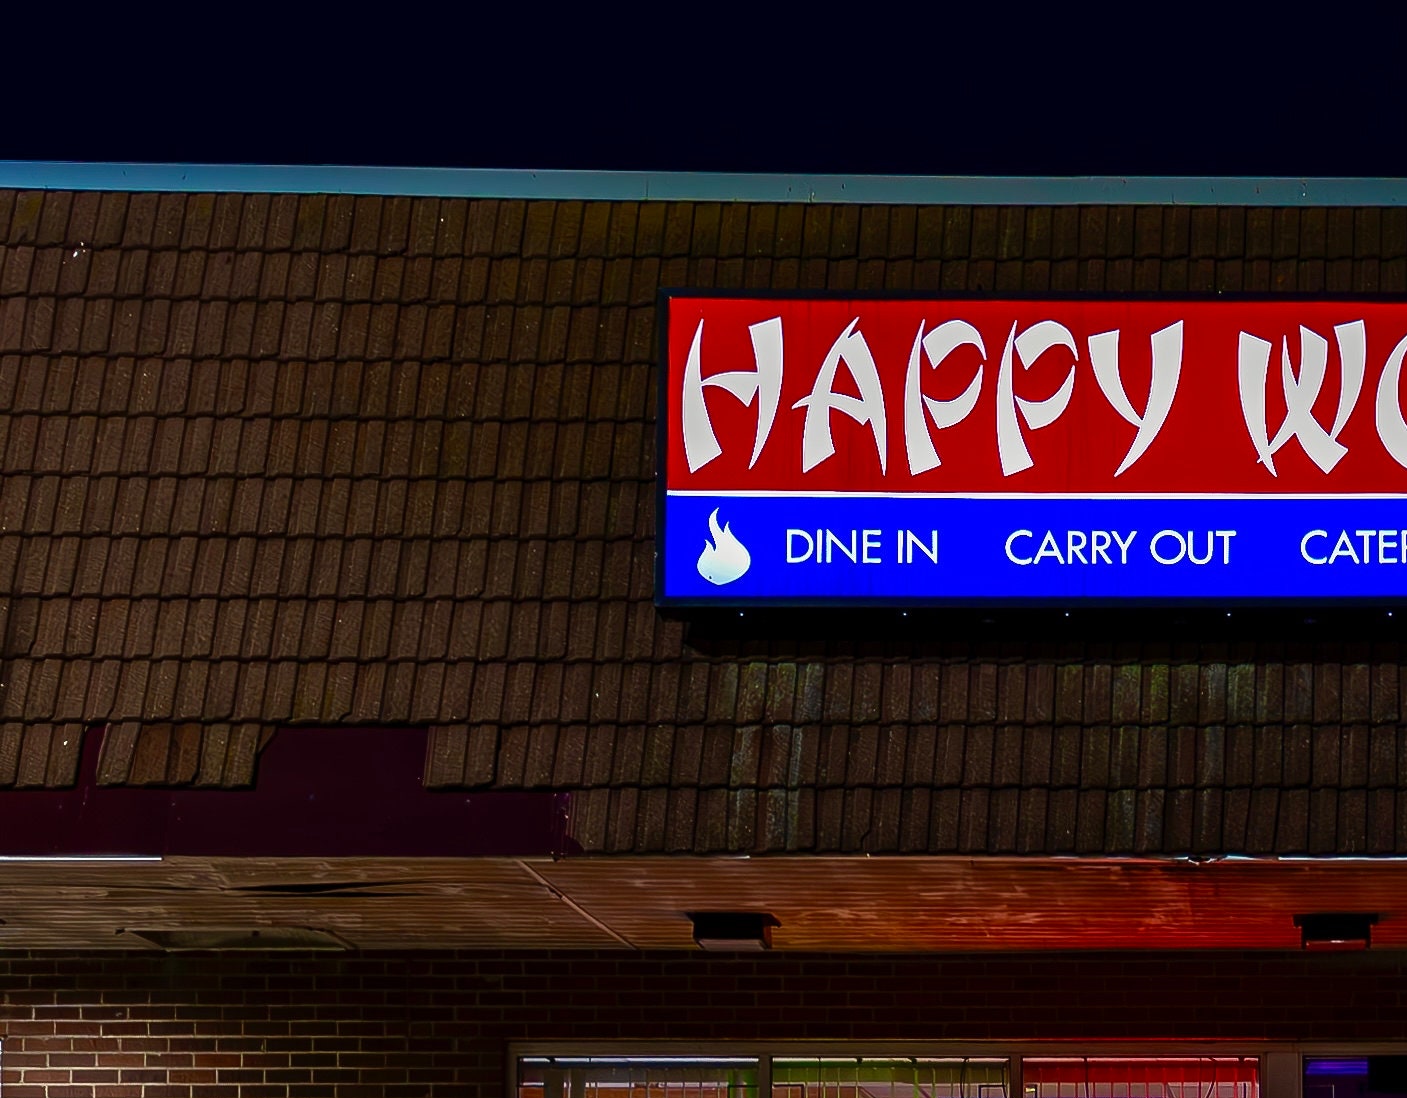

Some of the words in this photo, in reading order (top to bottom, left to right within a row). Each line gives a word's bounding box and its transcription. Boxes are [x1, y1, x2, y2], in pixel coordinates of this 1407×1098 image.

[681, 316, 1184, 478] HAPPY
[785, 529, 882, 565] DINE
[896, 529, 939, 565] IN
[1004, 529, 1138, 565] CARRY
[1149, 529, 1237, 566] OUT
